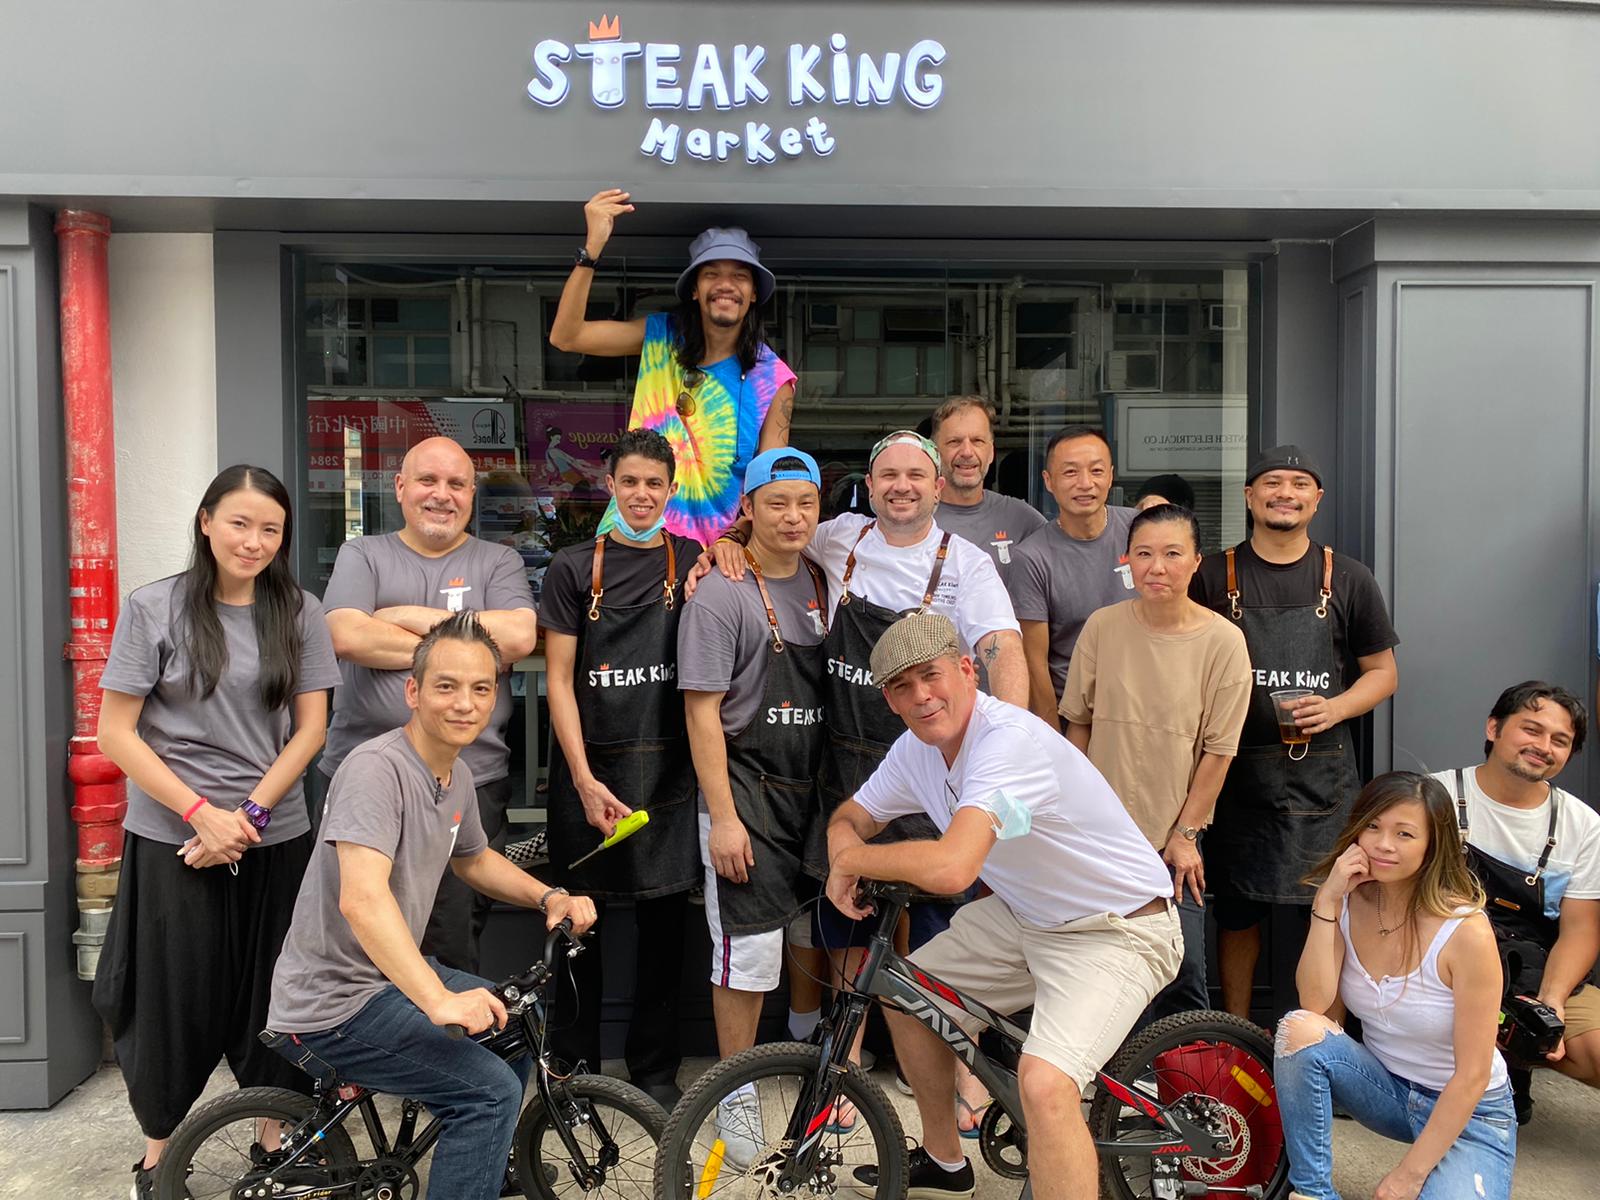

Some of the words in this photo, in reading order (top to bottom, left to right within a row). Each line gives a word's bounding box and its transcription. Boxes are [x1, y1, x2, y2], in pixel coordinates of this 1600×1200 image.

[527, 39, 770, 110] STEAK
[588, 666, 646, 688] STEAK
[827, 658, 874, 686] STEAK
[766, 707, 816, 725] STEAK
[892, 995, 975, 1066] JAVA
[1152, 1144, 1192, 1155] JAVA
